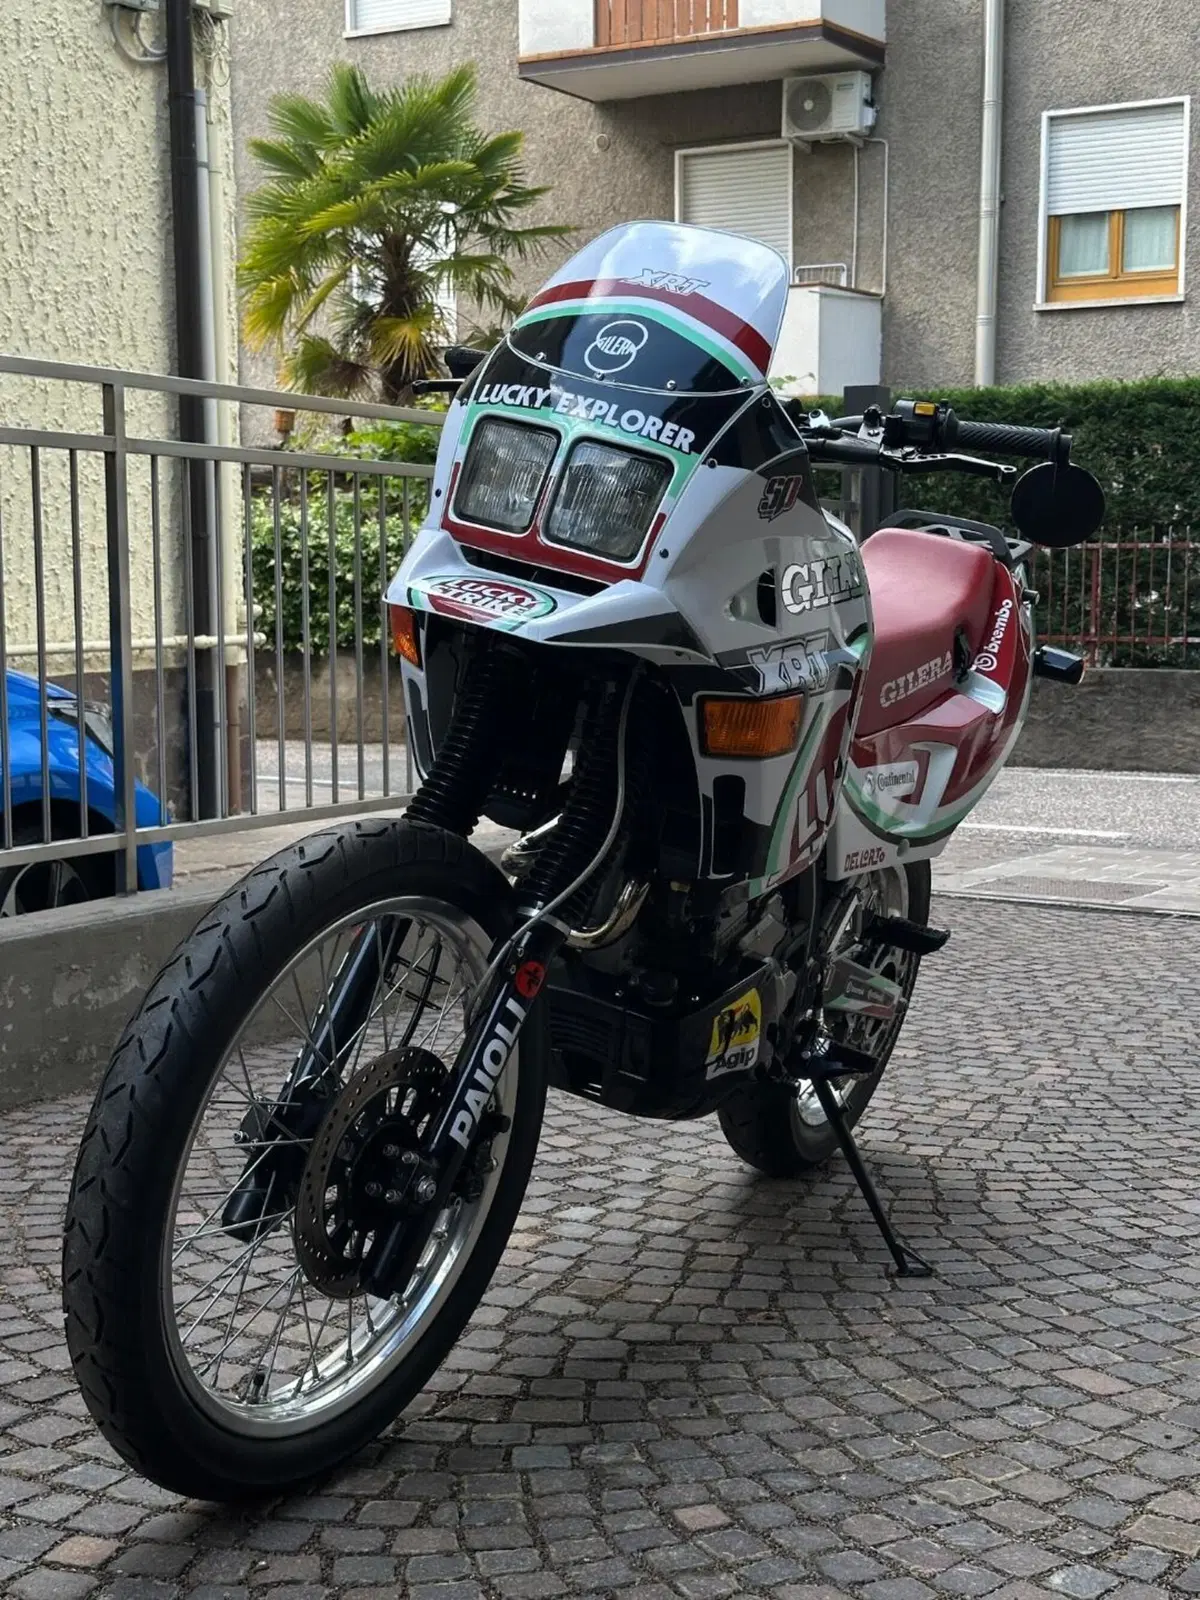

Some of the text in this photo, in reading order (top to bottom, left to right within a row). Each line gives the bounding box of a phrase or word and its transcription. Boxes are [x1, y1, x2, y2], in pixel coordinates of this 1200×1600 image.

[621, 268, 711, 296] XRT
[477, 383, 696, 454] LUCKY EXPLORER
[444, 579, 537, 608] LUCKY
[984, 598, 1013, 653] brembo
[746, 630, 829, 696] XRT
[880, 651, 952, 708] GILERA
[877, 768, 915, 791] Continental
[450, 997, 527, 1150] PAIOLI
[711, 1047, 755, 1073] Agip
